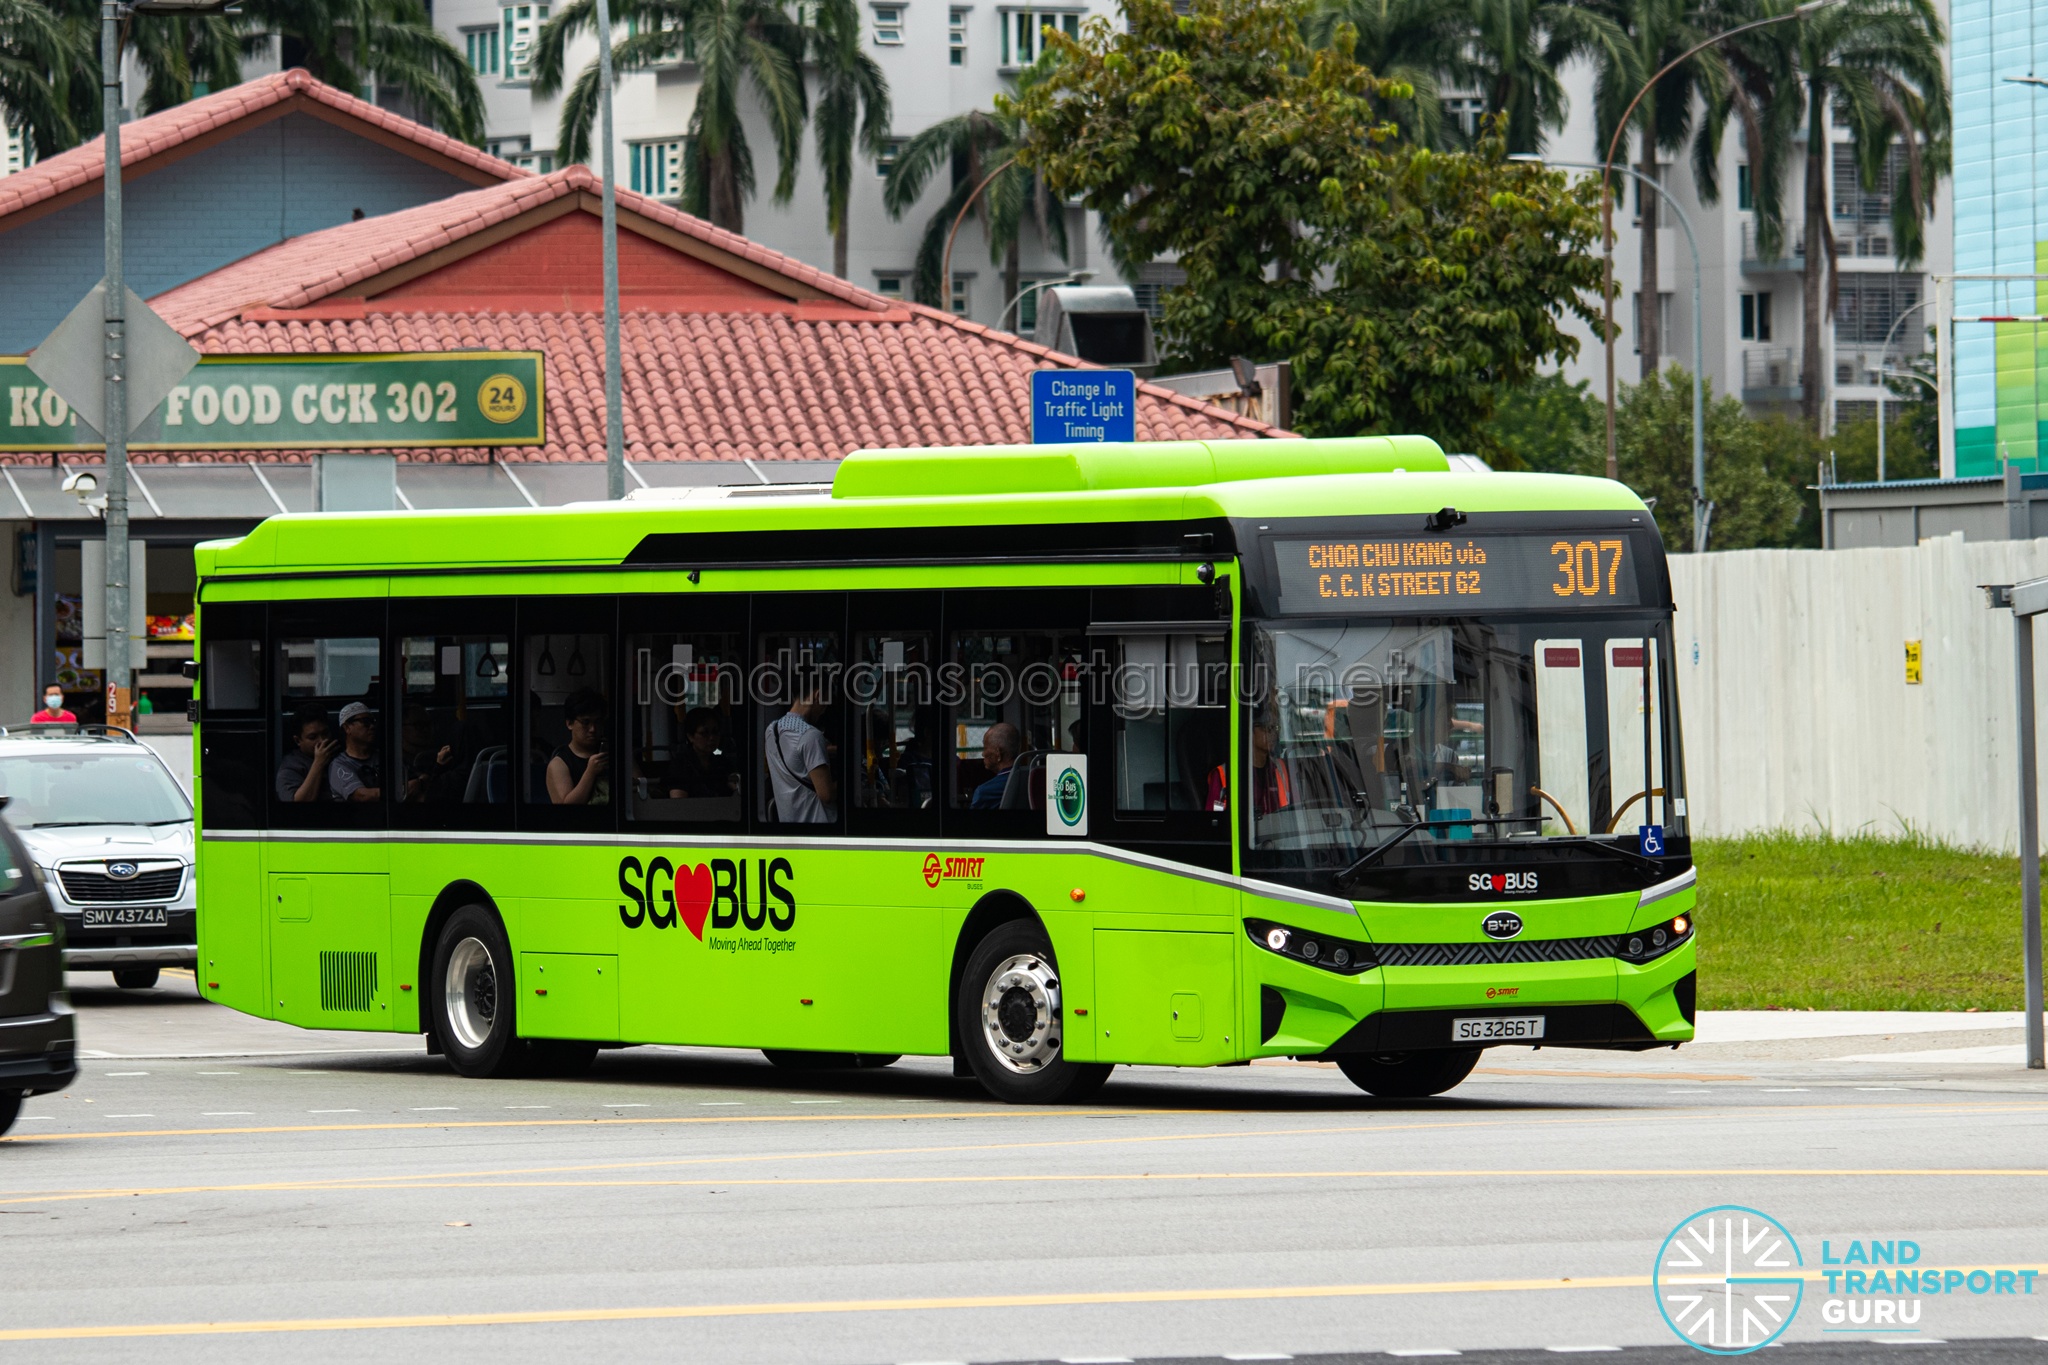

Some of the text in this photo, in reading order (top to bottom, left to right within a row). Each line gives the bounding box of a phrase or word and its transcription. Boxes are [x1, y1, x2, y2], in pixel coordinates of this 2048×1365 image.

[490, 387, 515, 404] 24
[1052, 381, 1116, 401] Change In
[165, 384, 282, 426] FOOD
[291, 383, 379, 425] CCK
[386, 381, 458, 424] 302
[1044, 401, 1124, 421] Traffic Light
[1064, 422, 1105, 442] Timing
[1309, 541, 1487, 568] CHOA CHU KANG via
[1551, 540, 1623, 597] 307
[1378, 571, 1452, 596] STREET
[1455, 570, 1481, 594] 62
[943, 857, 985, 878] SMRT
[1487, 919, 1520, 932] BYD
[709, 936, 797, 955] Moving Ahead Together
[1497, 987, 1520, 996] SMRT
